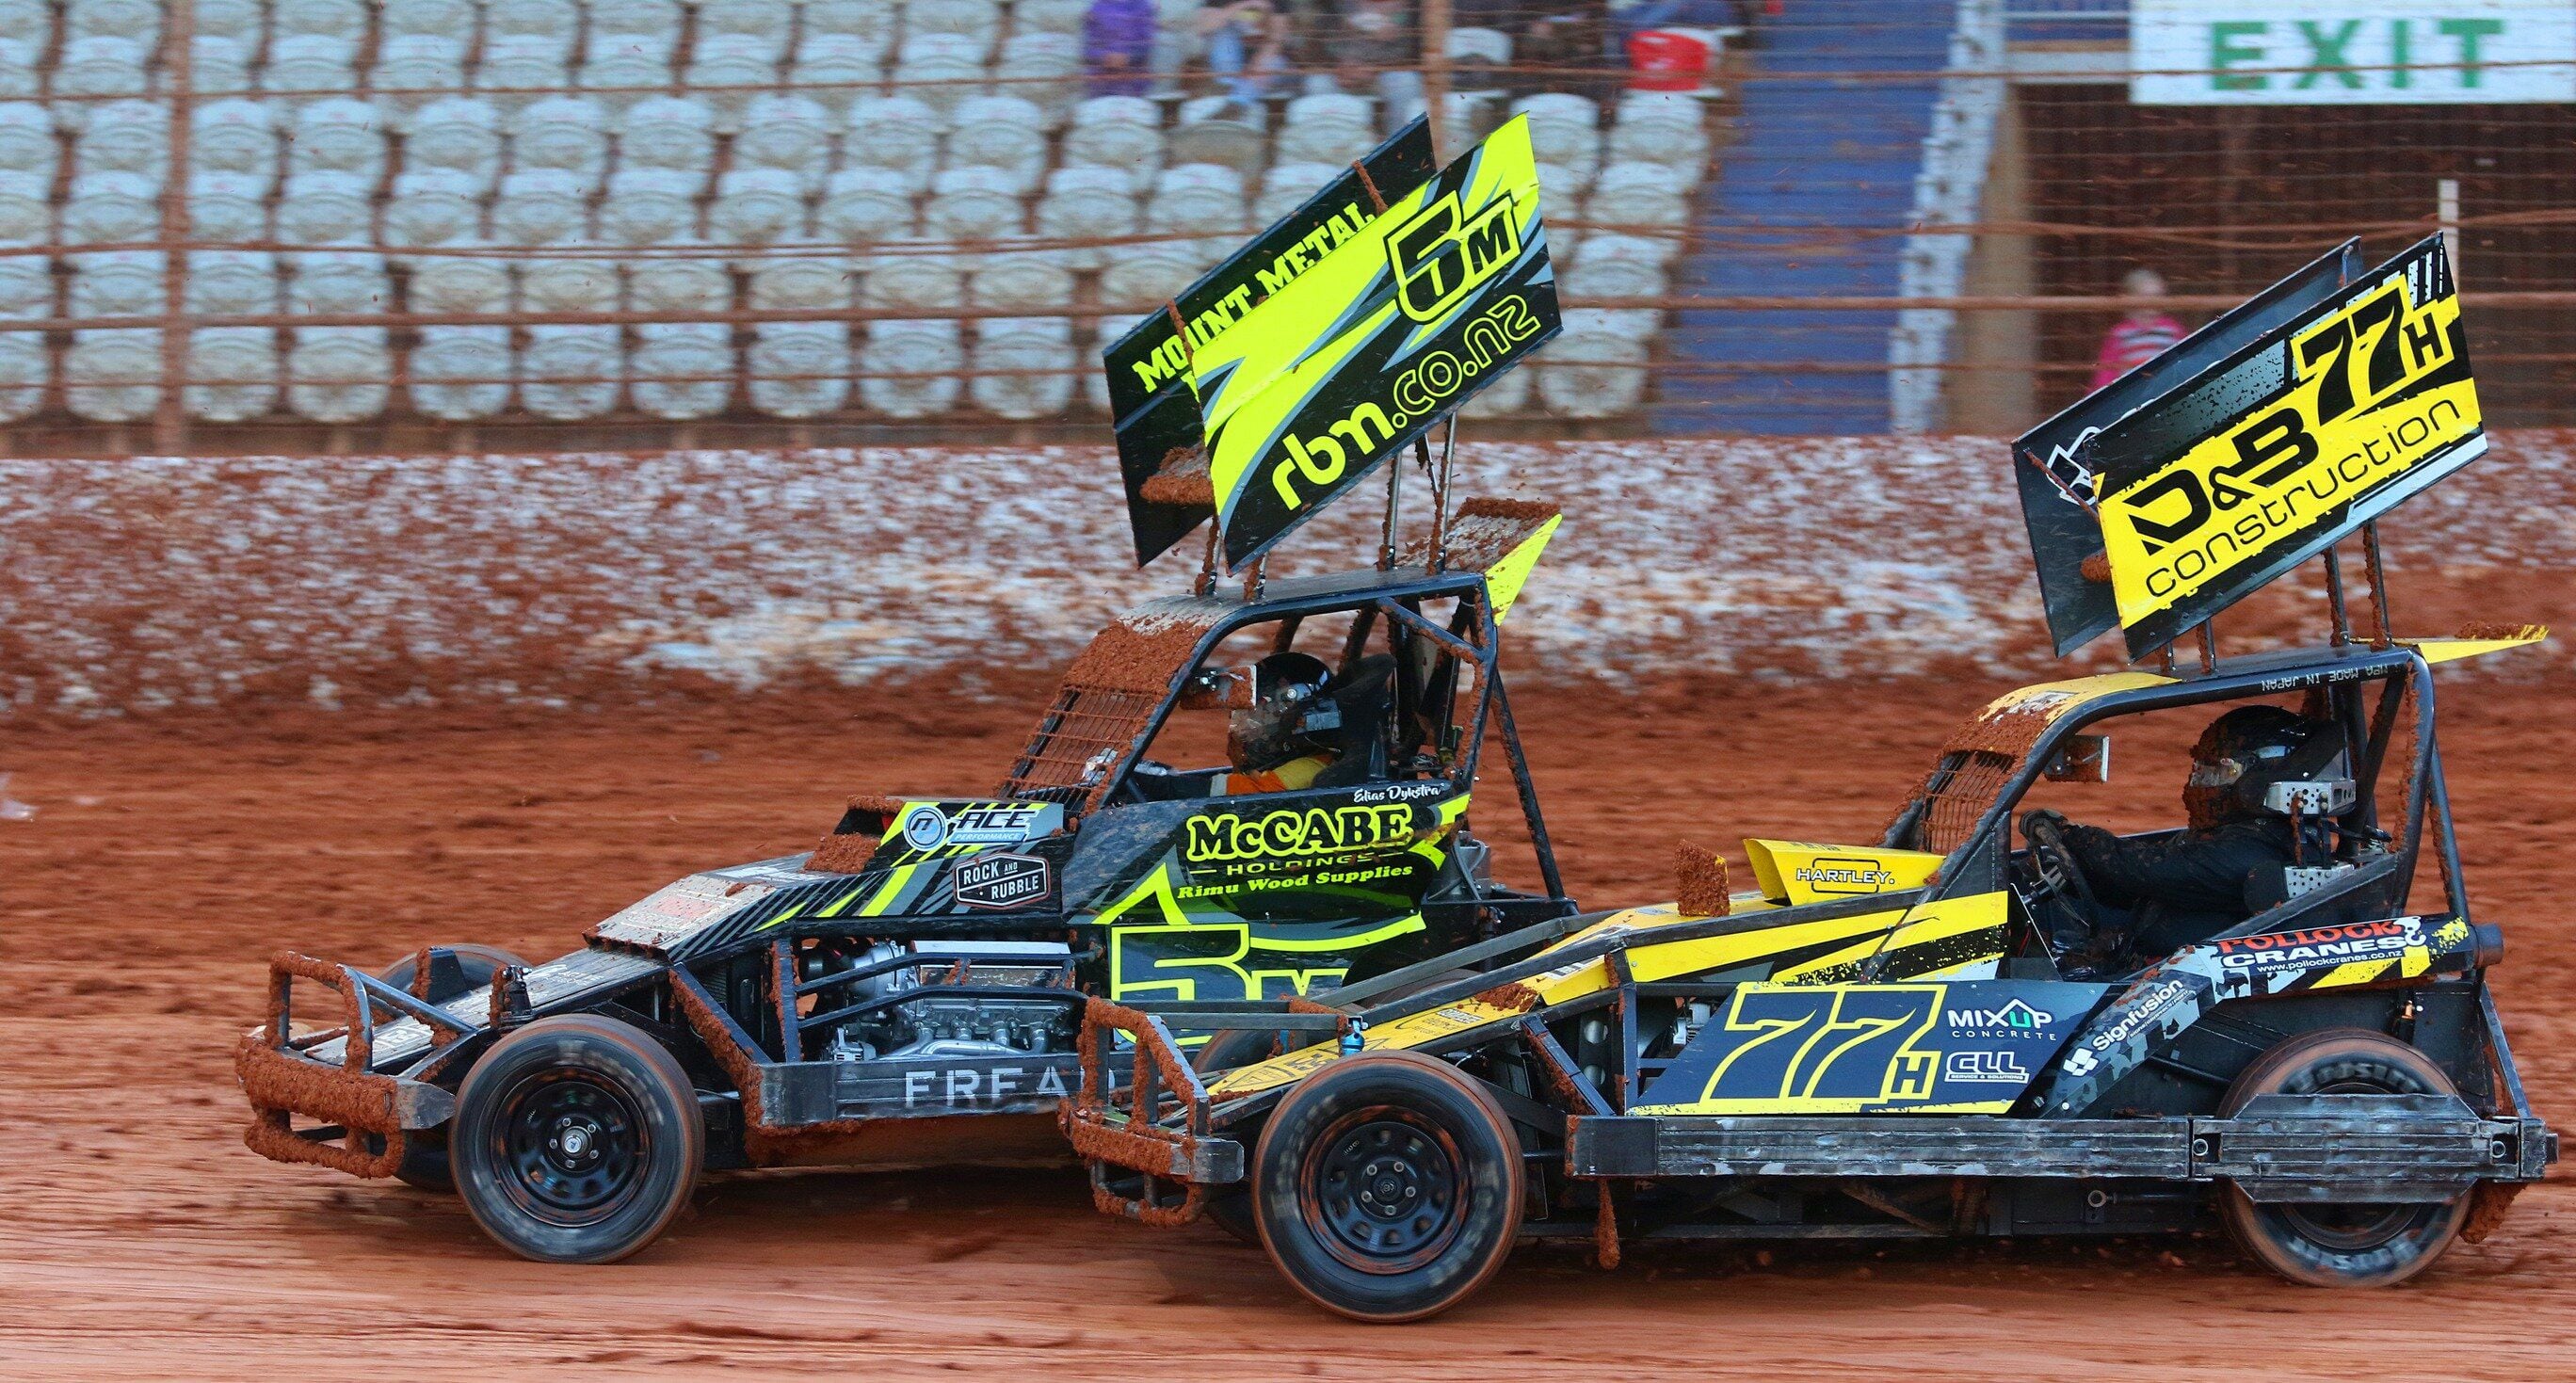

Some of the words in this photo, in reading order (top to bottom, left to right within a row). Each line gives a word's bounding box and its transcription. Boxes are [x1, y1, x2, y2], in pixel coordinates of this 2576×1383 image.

[2211, 19, 2504, 89] EXIT
[1388, 191, 1521, 322] 5M
[1132, 283, 1251, 394] MOUNT
[1254, 202, 1376, 297] METAL
[2299, 286, 2447, 427] 77H
[1271, 294, 1541, 511] rbm.co.nz
[2122, 406, 2320, 556] D&B
[2145, 396, 2462, 600] construction
[2261, 676, 2300, 692] JAPAN
[2307, 672, 2321, 685] IN
[2328, 667, 2359, 683] MADE
[1354, 788, 1385, 803] Elias
[1388, 785, 1441, 802] Dykstra
[955, 830, 1022, 842] PERFORMANCE
[957, 810, 1037, 829] ACE
[1186, 803, 1414, 862] McCABE
[963, 860, 999, 885] ROCK
[1004, 862, 1018, 873] AND
[1227, 852, 1375, 876] HOLDINGS
[991, 875, 1038, 900] RUBBLE
[1177, 882, 1239, 899] Rimu
[1247, 873, 1309, 892] Wood
[1315, 864, 1413, 887] Supplies
[2217, 920, 2403, 954] POLLOCK
[2222, 935, 2408, 968] CRANES
[2257, 950, 2403, 973] www.pollockcranes.co.nz
[1947, 1002, 2053, 1029] MIXUP
[2092, 979, 2184, 1052] Signfusion
[1700, 984, 1947, 1103] 77H
[1952, 1030, 2057, 1041] CONCRETE
